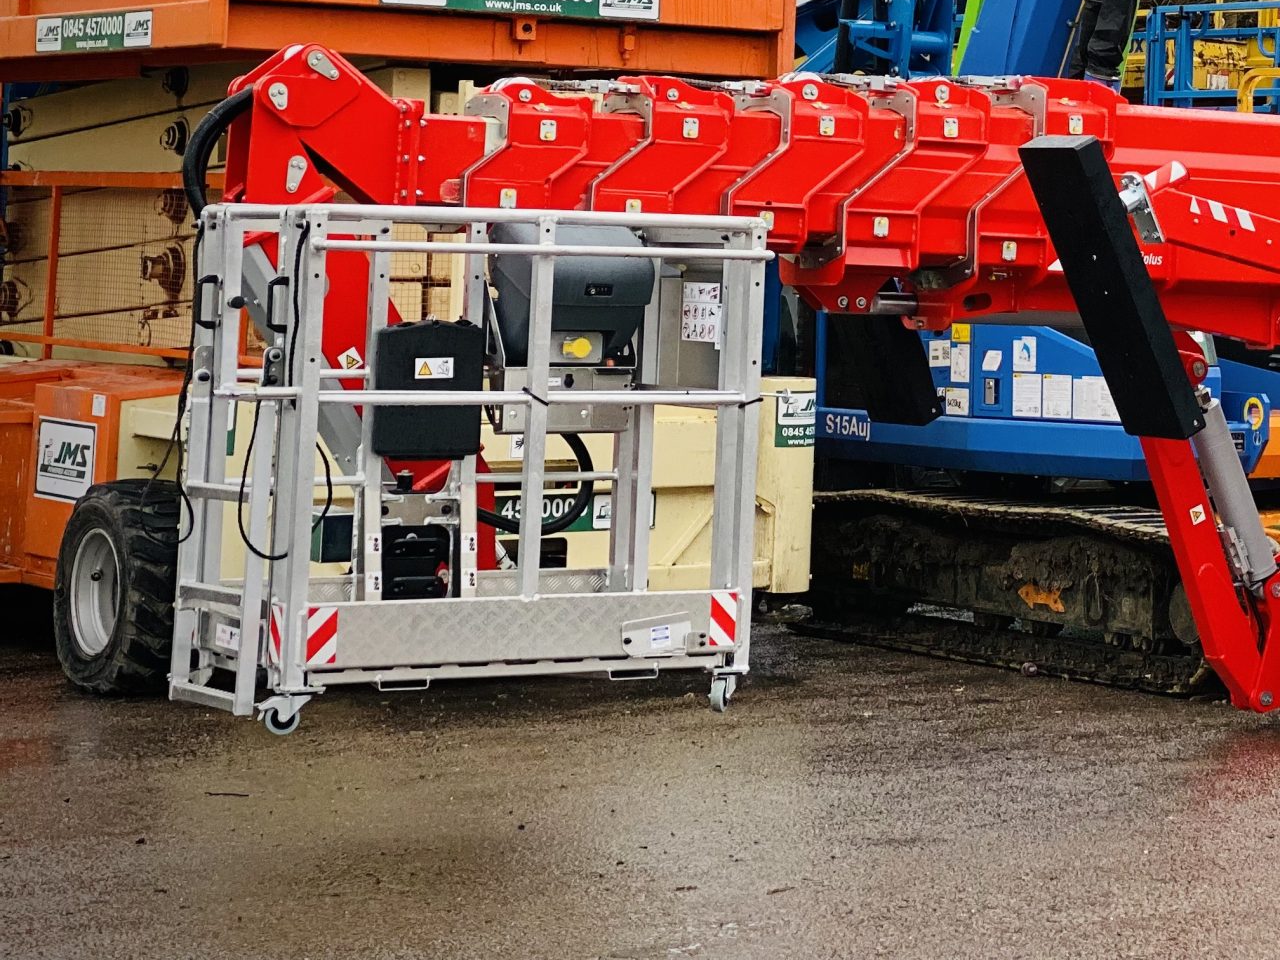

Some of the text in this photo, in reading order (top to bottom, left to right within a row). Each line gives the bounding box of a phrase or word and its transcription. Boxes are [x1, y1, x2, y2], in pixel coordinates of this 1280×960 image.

[485, 0, 562, 13] www.jms.co.uk
[44, 15, 150, 38] JMS 0845 4570000 JMS
[781, 427, 805, 437] 0845
[825, 413, 873, 442] S15Auj
[53, 441, 91, 468] JMS
